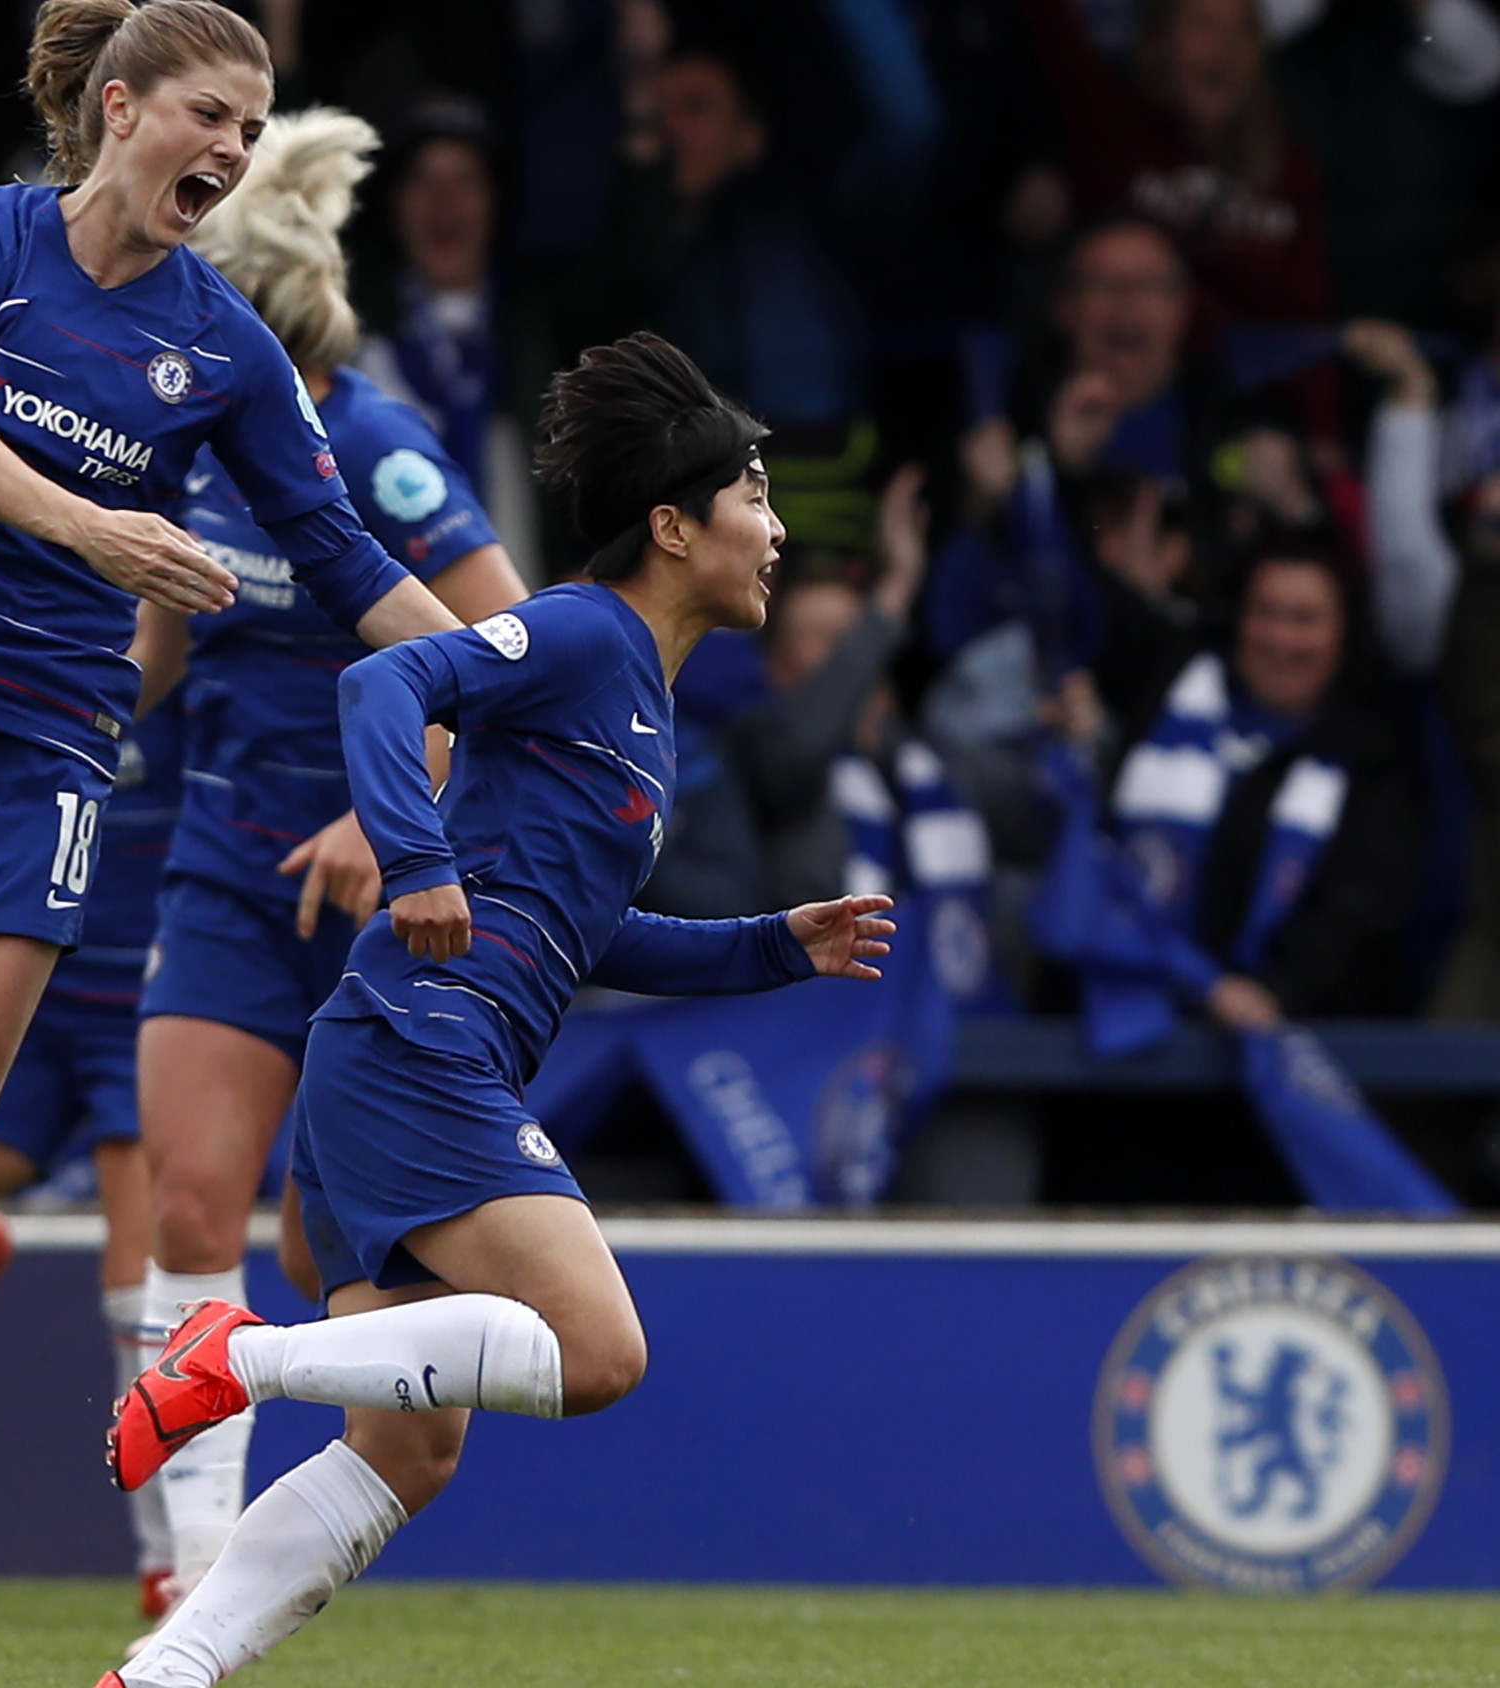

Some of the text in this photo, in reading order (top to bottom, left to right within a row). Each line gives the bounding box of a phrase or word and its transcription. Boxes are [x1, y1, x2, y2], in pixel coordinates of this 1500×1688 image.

[2, 384, 154, 472] YOKOHAMA
[77, 456, 140, 487] TYRES
[50, 791, 99, 895] 18
